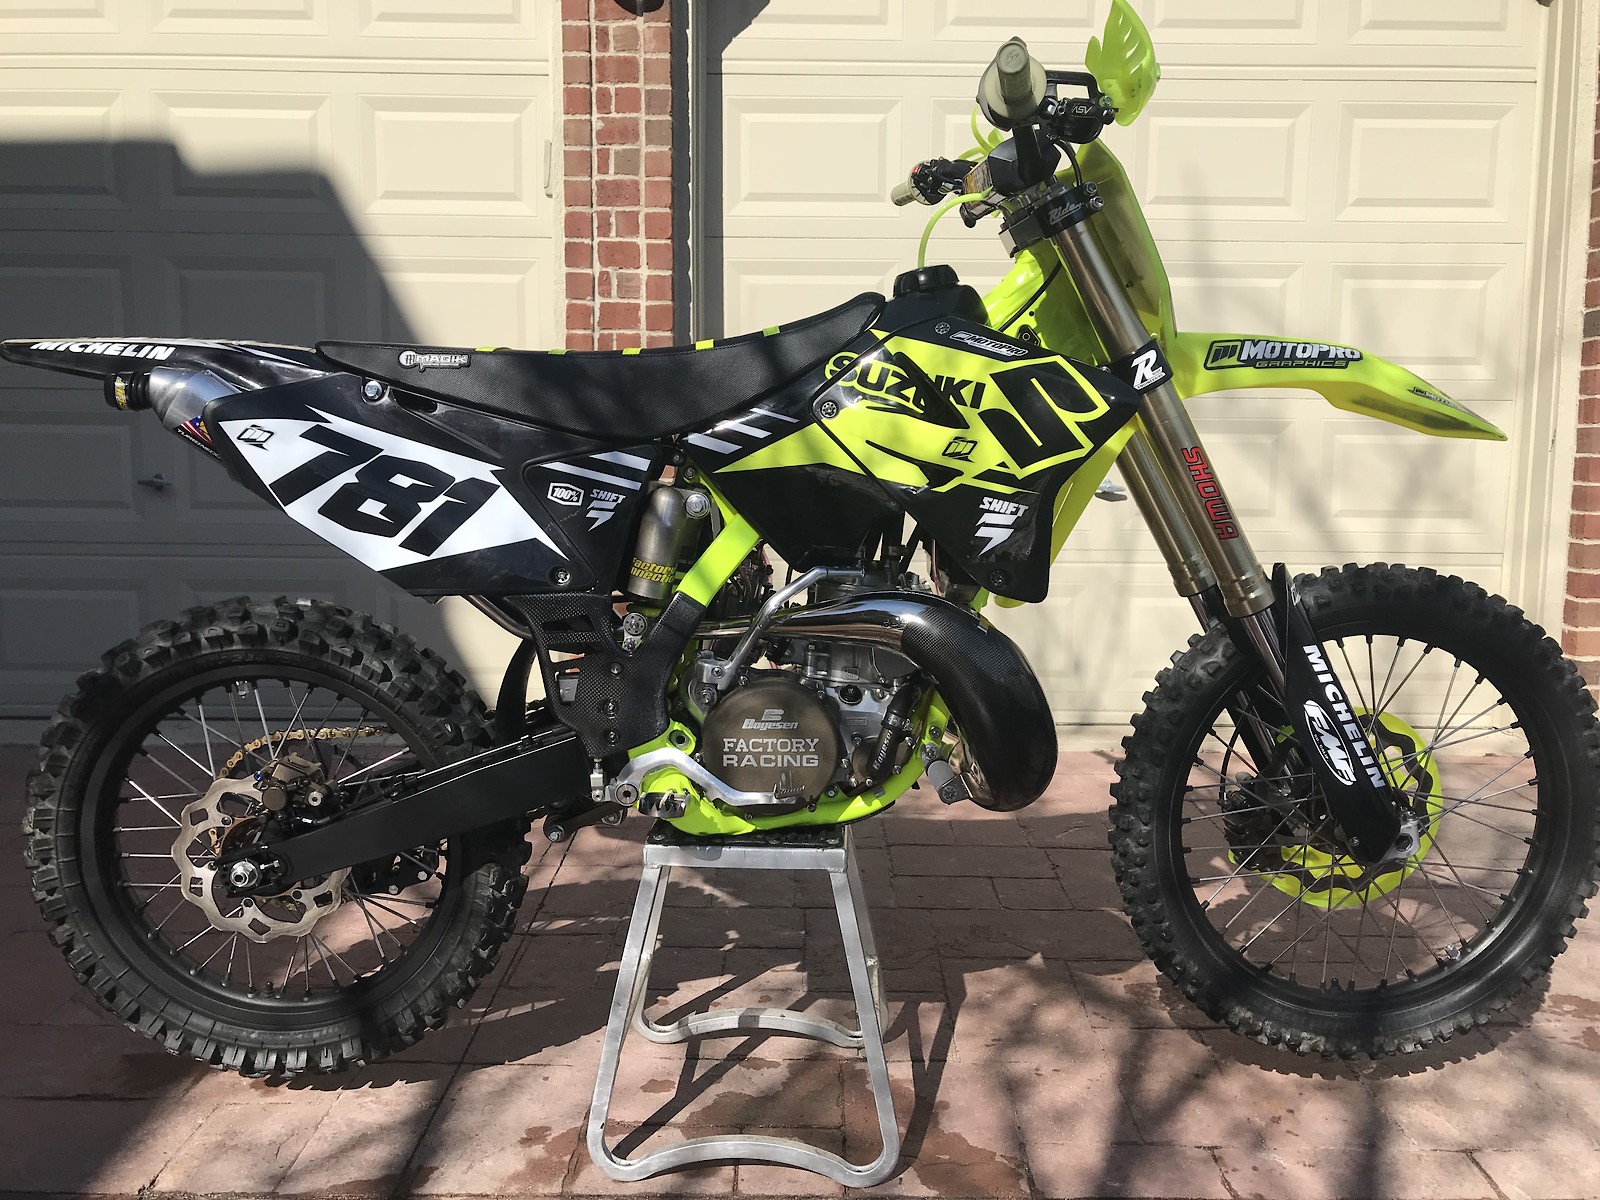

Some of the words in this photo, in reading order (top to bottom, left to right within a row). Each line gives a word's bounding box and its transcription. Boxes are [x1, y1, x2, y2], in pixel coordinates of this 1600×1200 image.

[30, 341, 176, 361] MICHELIN
[1240, 340, 1362, 361] MOTOPRO
[1255, 360, 1347, 368] GRAPHICS
[269, 423, 501, 557] 781
[552, 487, 580, 502] 100%
[590, 488, 627, 504] SHIFT
[1181, 446, 1240, 540] SHOWA
[979, 496, 1029, 518] SHIFT
[742, 718, 799, 731] Boyesen
[1303, 644, 1386, 789] MICHELIN
[723, 738, 820, 753] FACTORY
[1303, 701, 1357, 785] FMF
[723, 754, 819, 767] RACING
